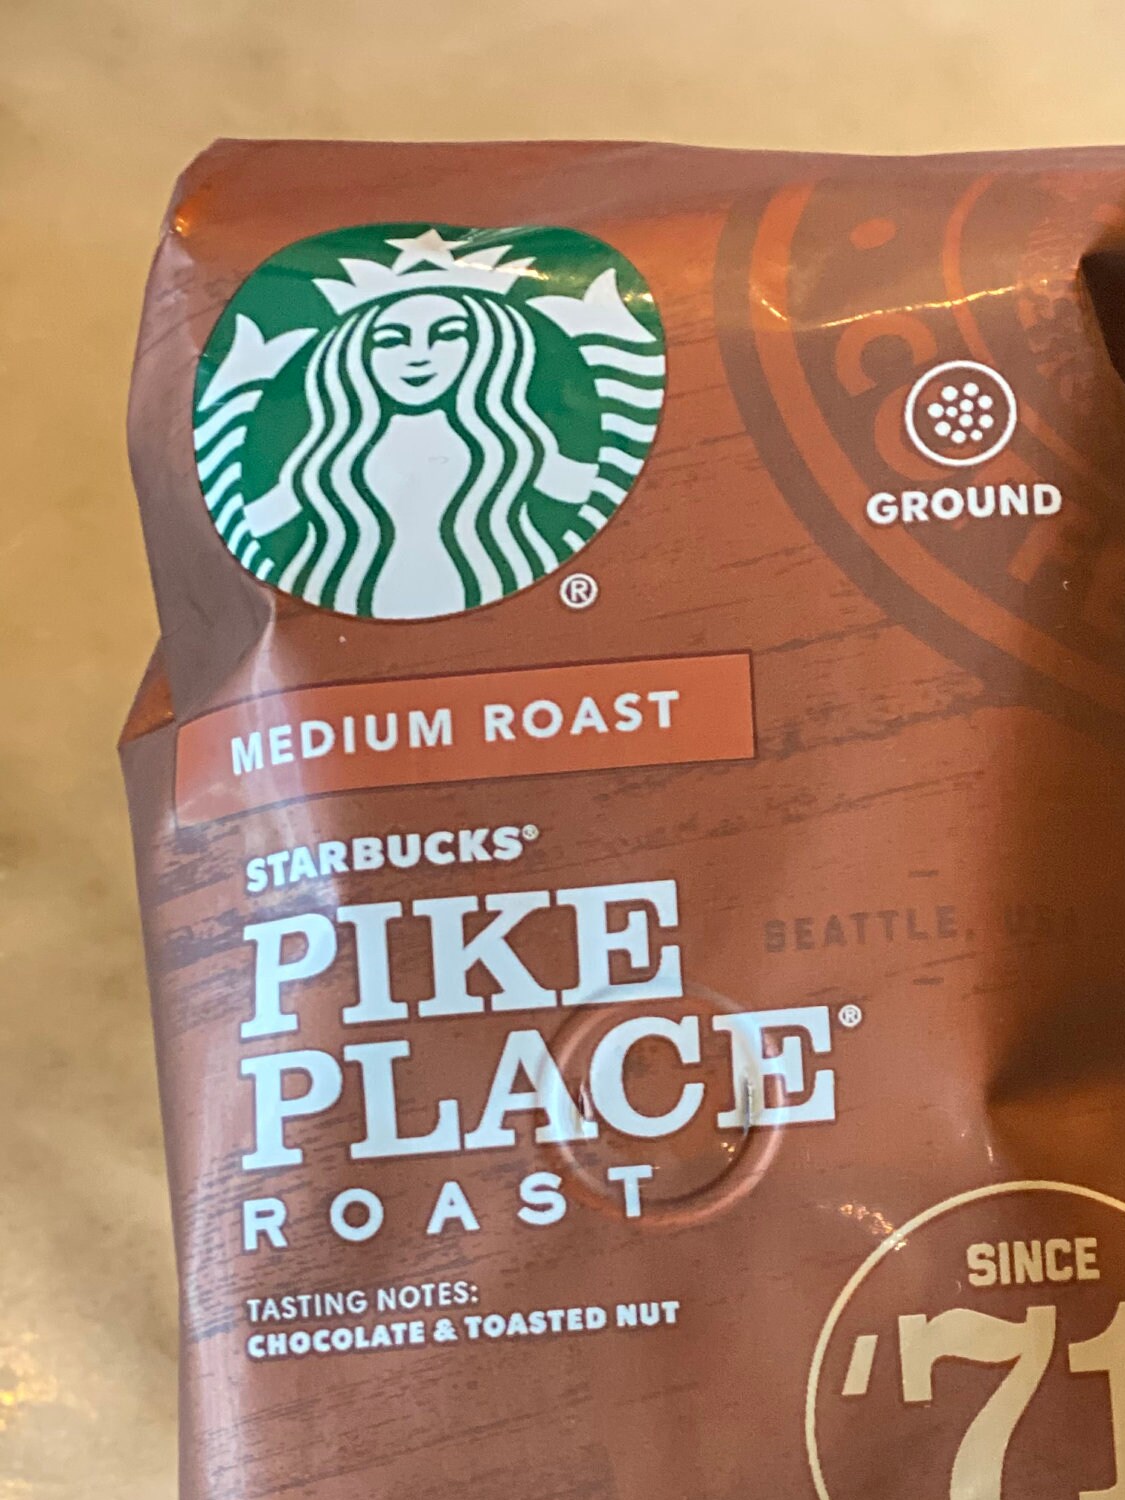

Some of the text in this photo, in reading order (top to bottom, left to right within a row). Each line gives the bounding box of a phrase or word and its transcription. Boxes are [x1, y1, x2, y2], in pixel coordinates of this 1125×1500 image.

[866, 483, 1063, 525] GROUND
[230, 690, 682, 774] MEDIUM ROAST
[240, 880, 683, 1039] PIKE
[243, 1164, 652, 1251] ROAST
[967, 1237, 1100, 1287] SINCE
[247, 1300, 680, 1358] CHOCOLATE & TOASTED NUT
[248, 1281, 479, 1322] TASTING NOTES:
